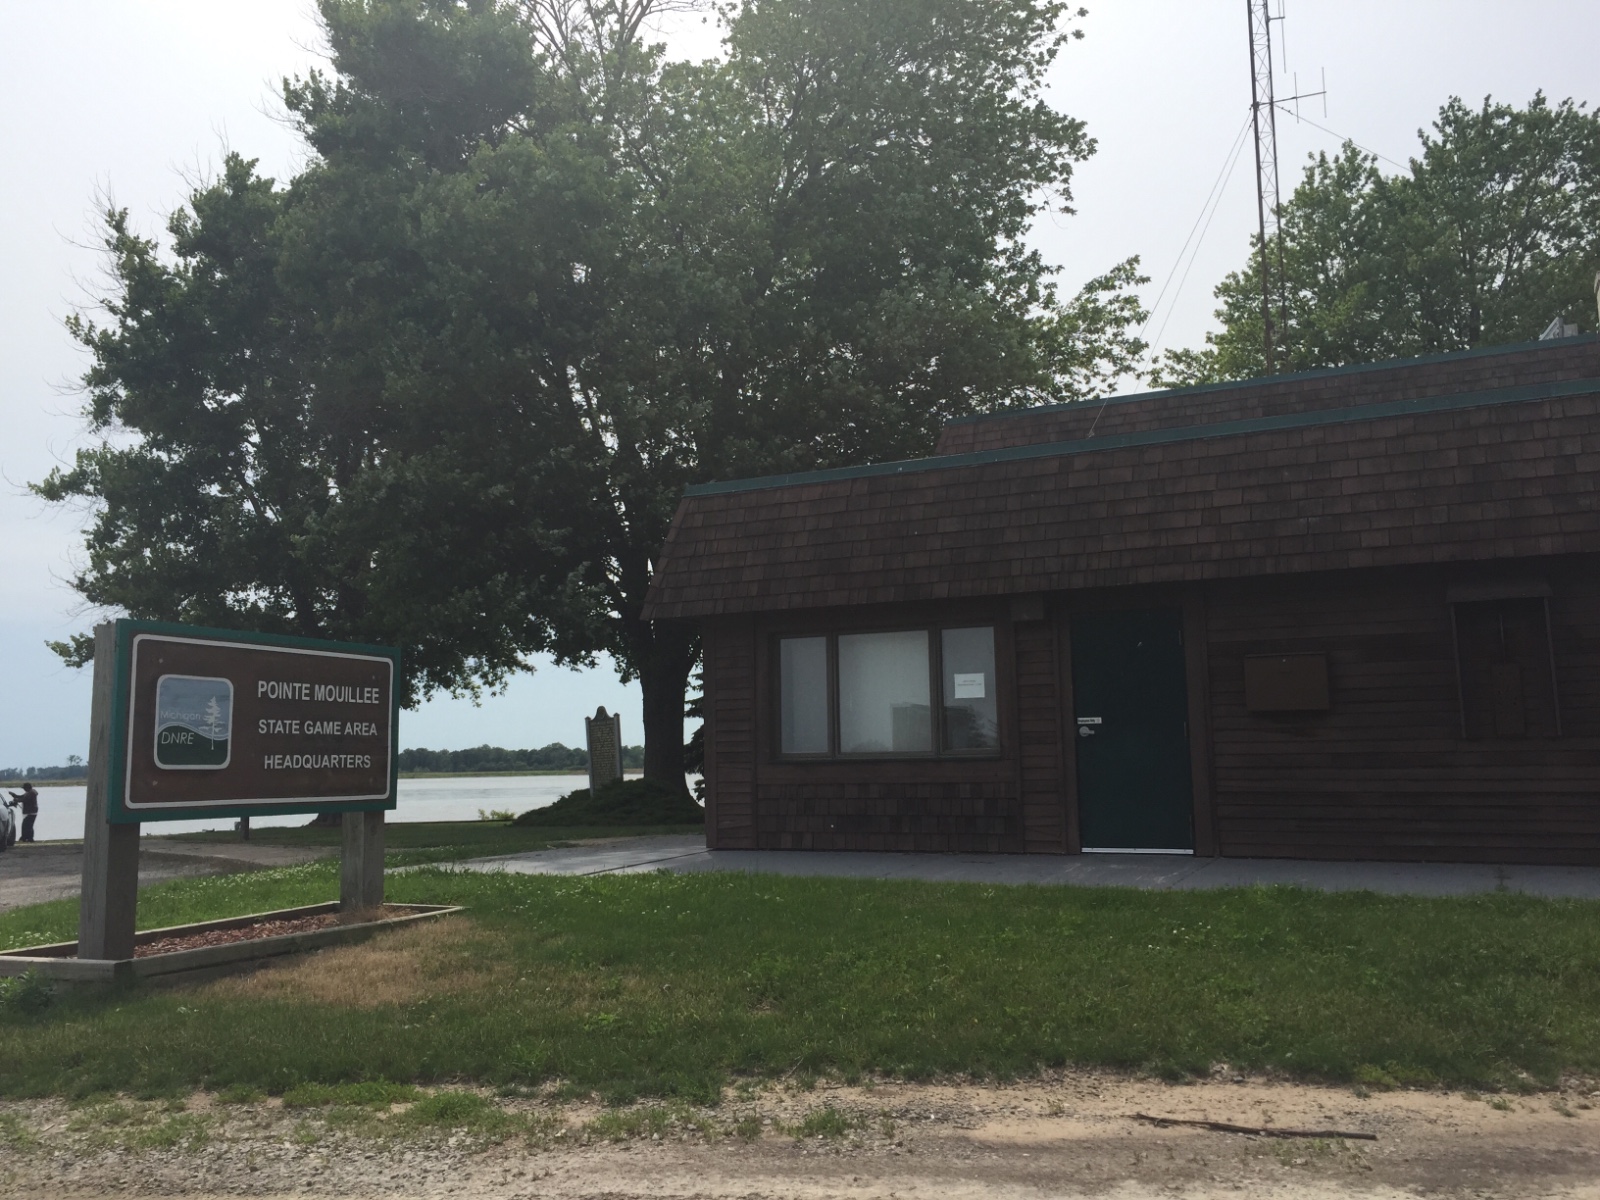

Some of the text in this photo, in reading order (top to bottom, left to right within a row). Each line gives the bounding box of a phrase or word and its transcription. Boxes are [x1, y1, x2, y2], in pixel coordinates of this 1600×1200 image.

[258, 680, 379, 704] POINTE MOUILLEE
[160, 710, 201, 721] Michigan
[258, 719, 378, 736] STATE GAME AREA
[161, 731, 194, 745] DNRE
[264, 755, 371, 769] HEADQUARTERS
